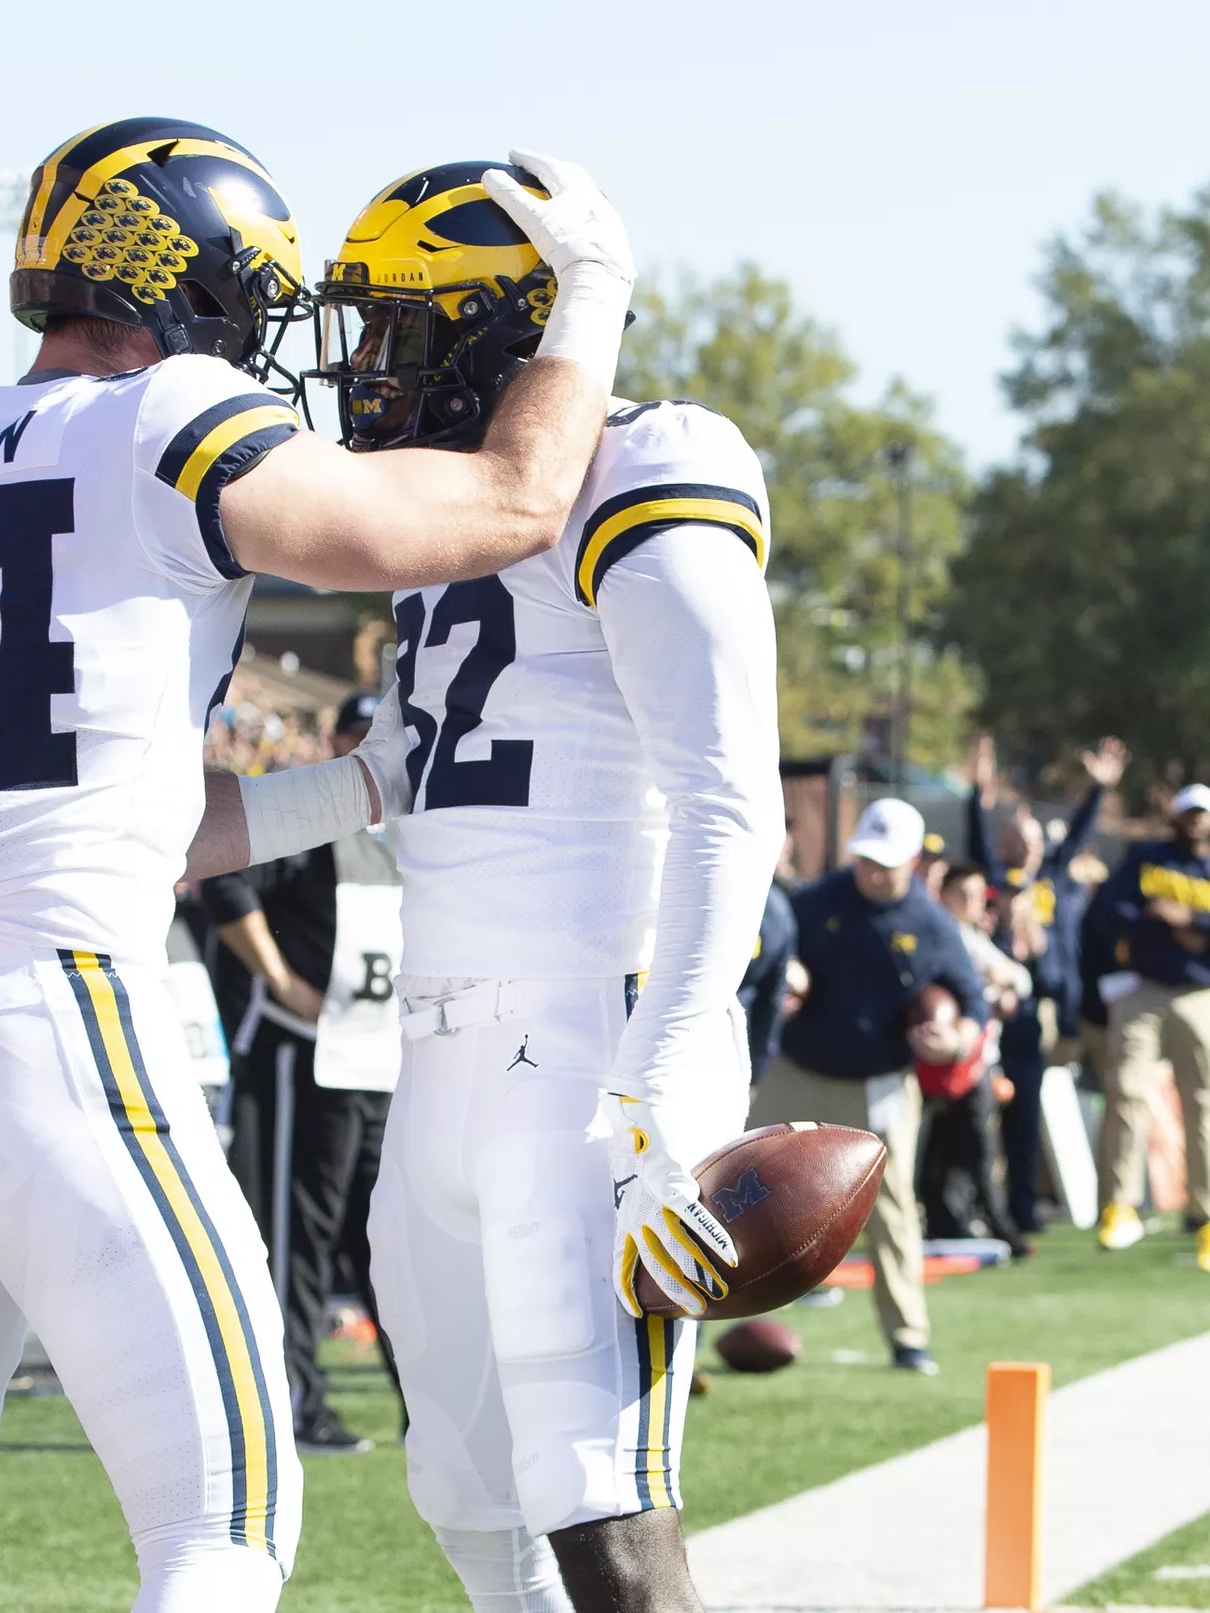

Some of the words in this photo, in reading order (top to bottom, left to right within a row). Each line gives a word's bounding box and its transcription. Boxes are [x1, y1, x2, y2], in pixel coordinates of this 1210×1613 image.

[331, 263, 346, 281] M
[377, 271, 423, 284] JORDAN
[363, 398, 382, 414] M
[354, 952, 394, 1003] B
[710, 1167, 774, 1223] M
[686, 1201, 730, 1250] MICHIGAN
